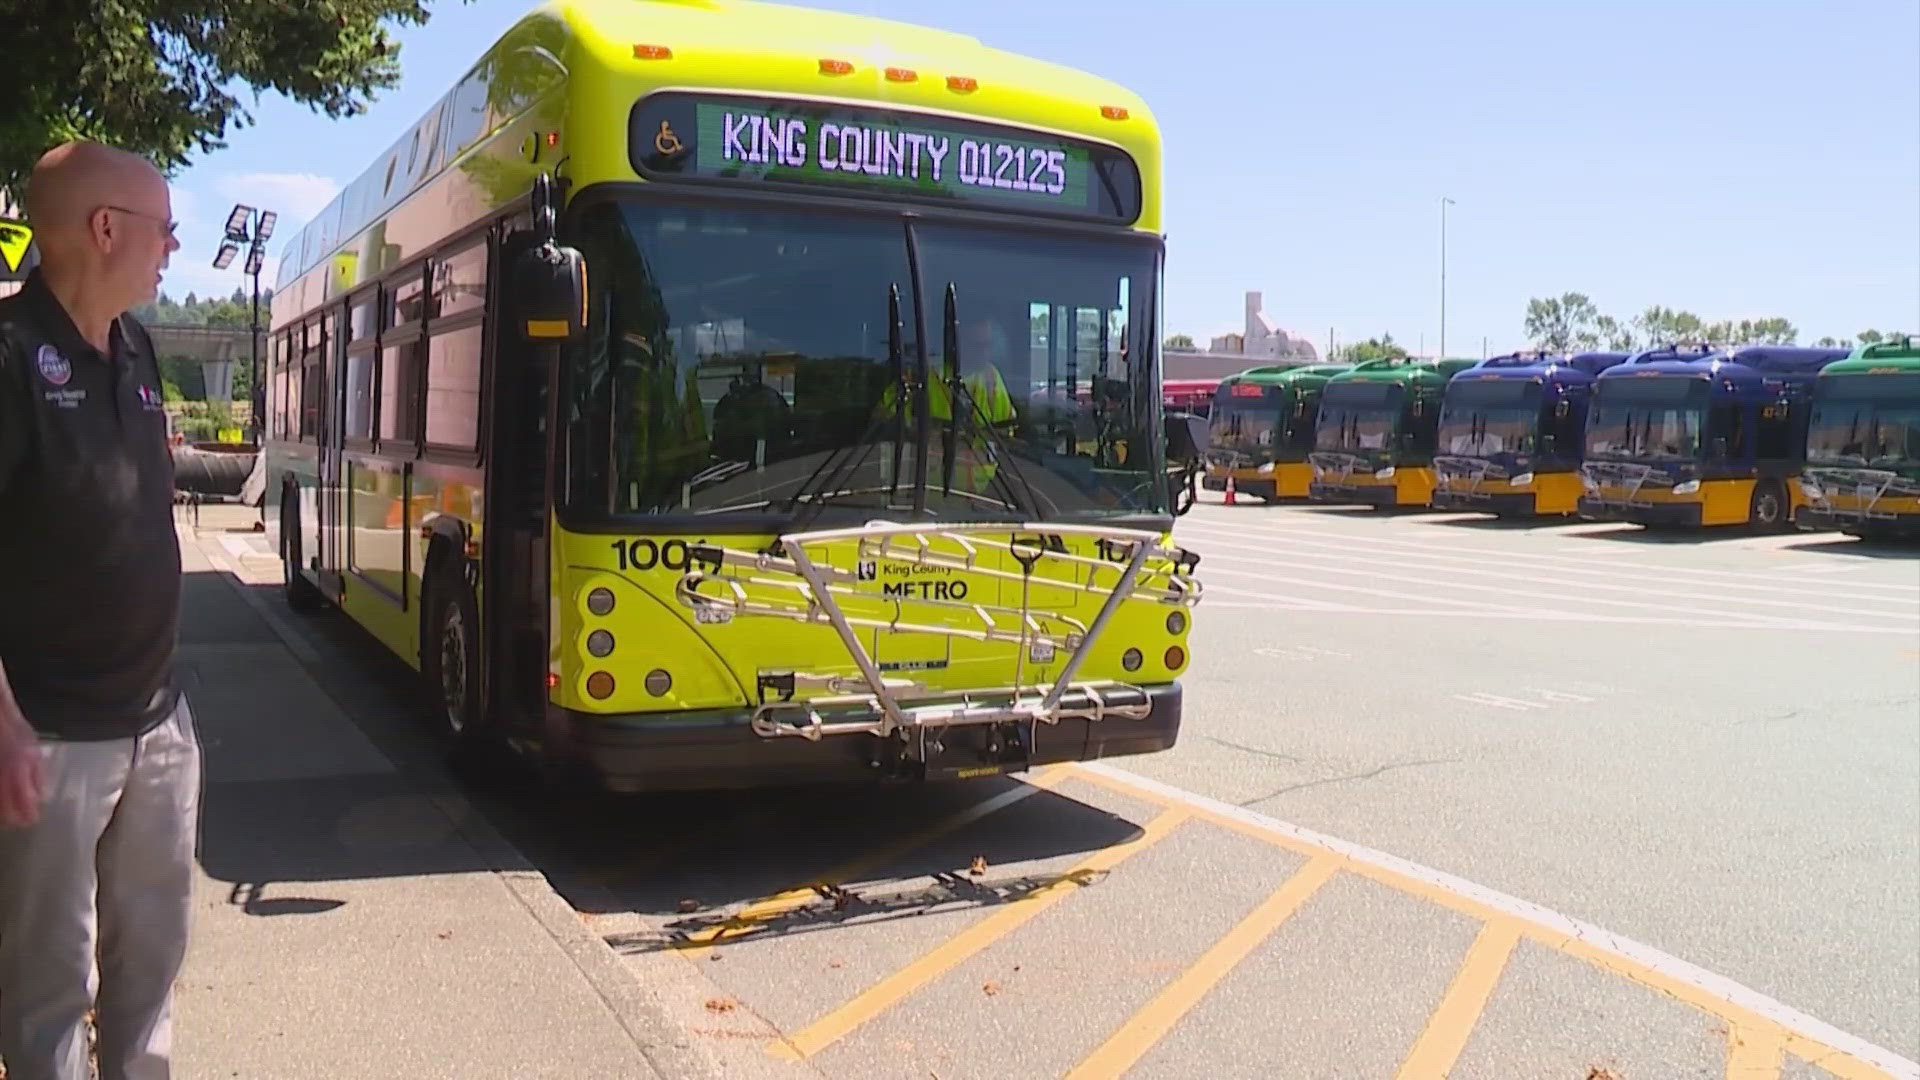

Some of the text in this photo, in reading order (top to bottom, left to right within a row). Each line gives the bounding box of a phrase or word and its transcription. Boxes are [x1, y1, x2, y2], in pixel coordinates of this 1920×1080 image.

[722, 113, 1066, 195] KING COUNTY 012125
[884, 564, 910, 577] King
[884, 580, 967, 602] METRO
